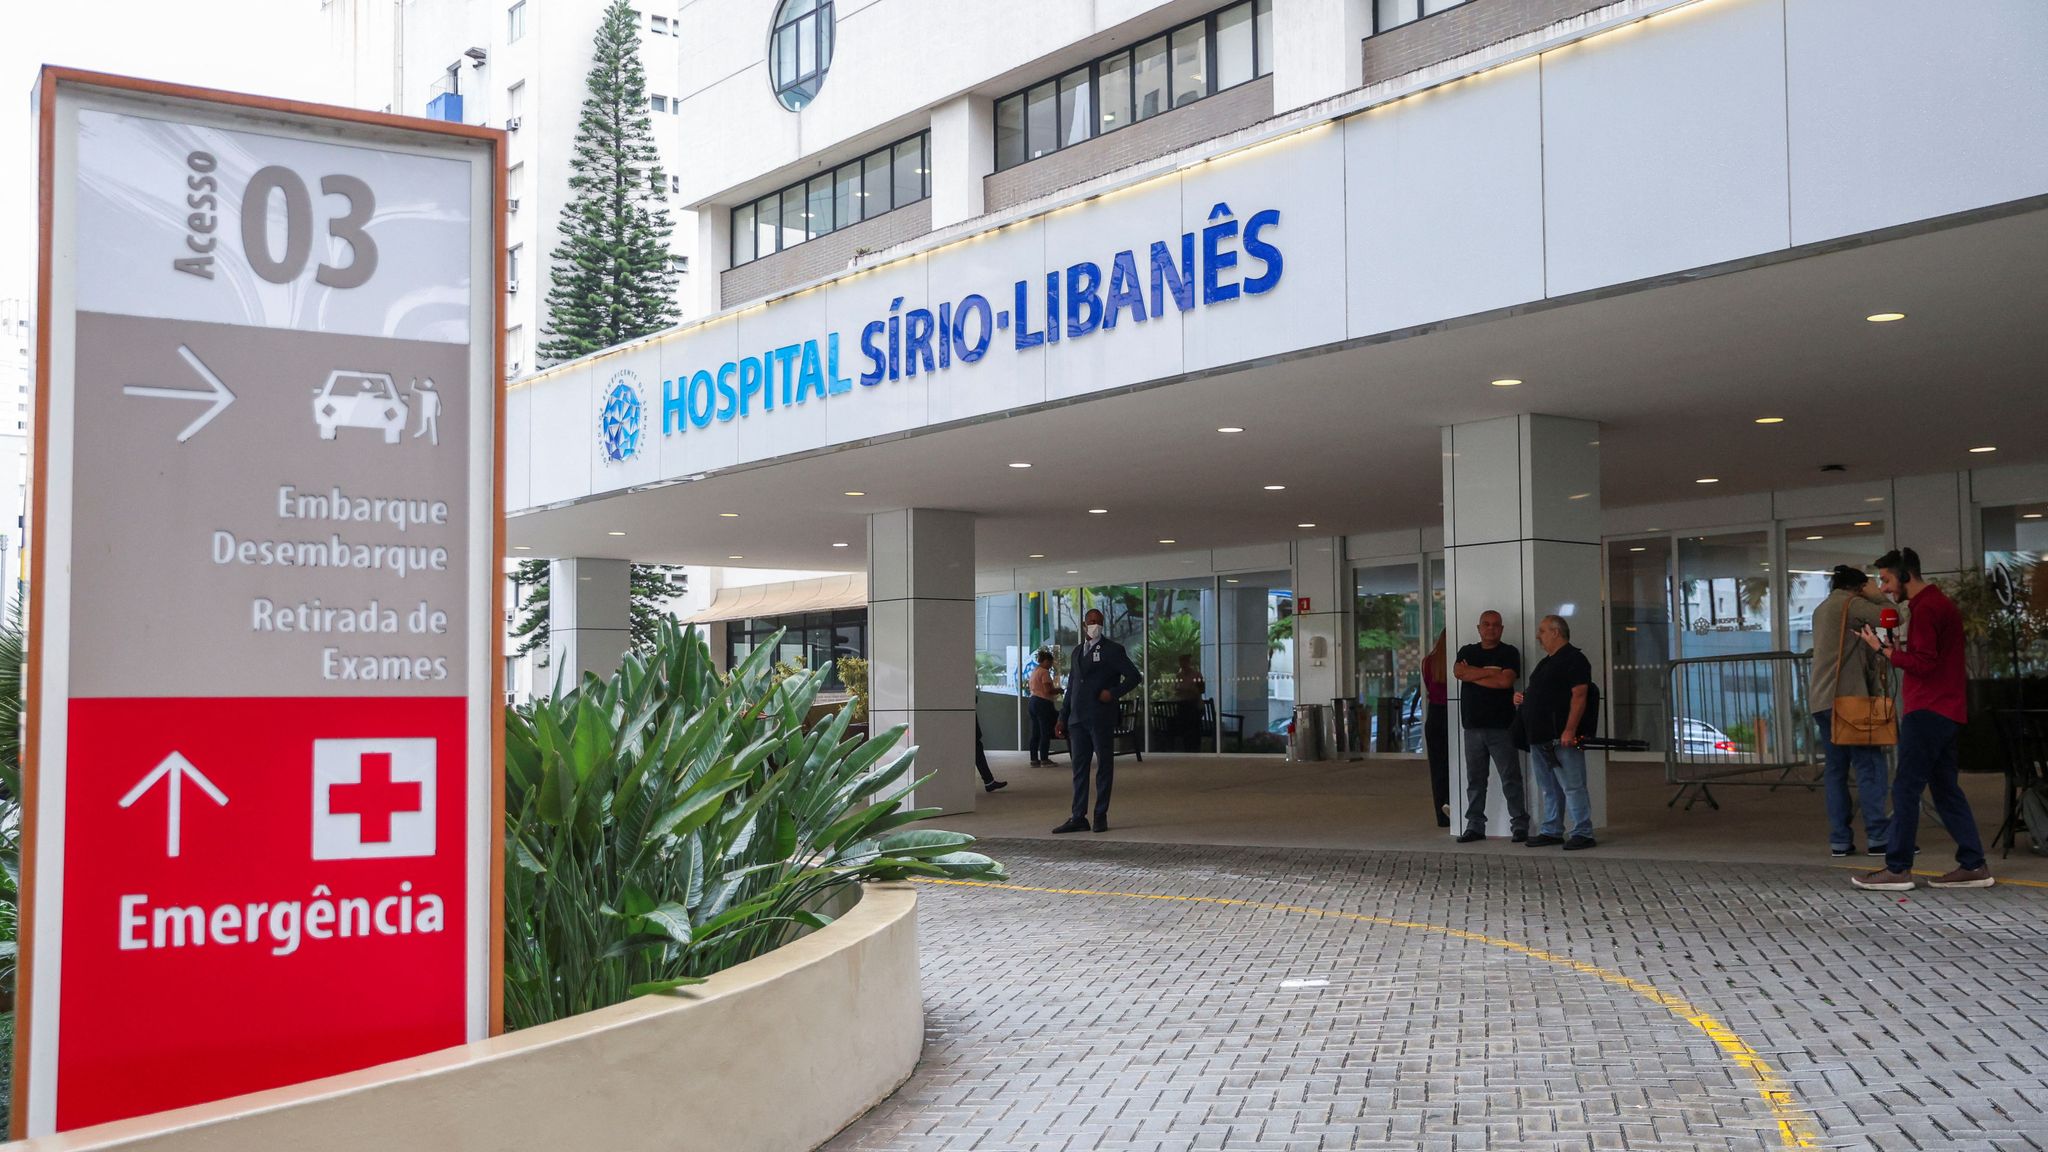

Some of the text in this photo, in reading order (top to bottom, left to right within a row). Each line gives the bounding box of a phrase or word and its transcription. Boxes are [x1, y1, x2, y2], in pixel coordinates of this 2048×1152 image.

[174, 150, 218, 280] Acesso
[240, 164, 379, 289] 03
[662, 202, 1285, 437] HOSPITAL SÍRIO-LIBANÊS
[277, 484, 449, 532] Embarque
[211, 530, 449, 578] Desembarque
[252, 598, 448, 634] Retirada de
[321, 647, 449, 681] Exames
[118, 881, 446, 957] Emergência
